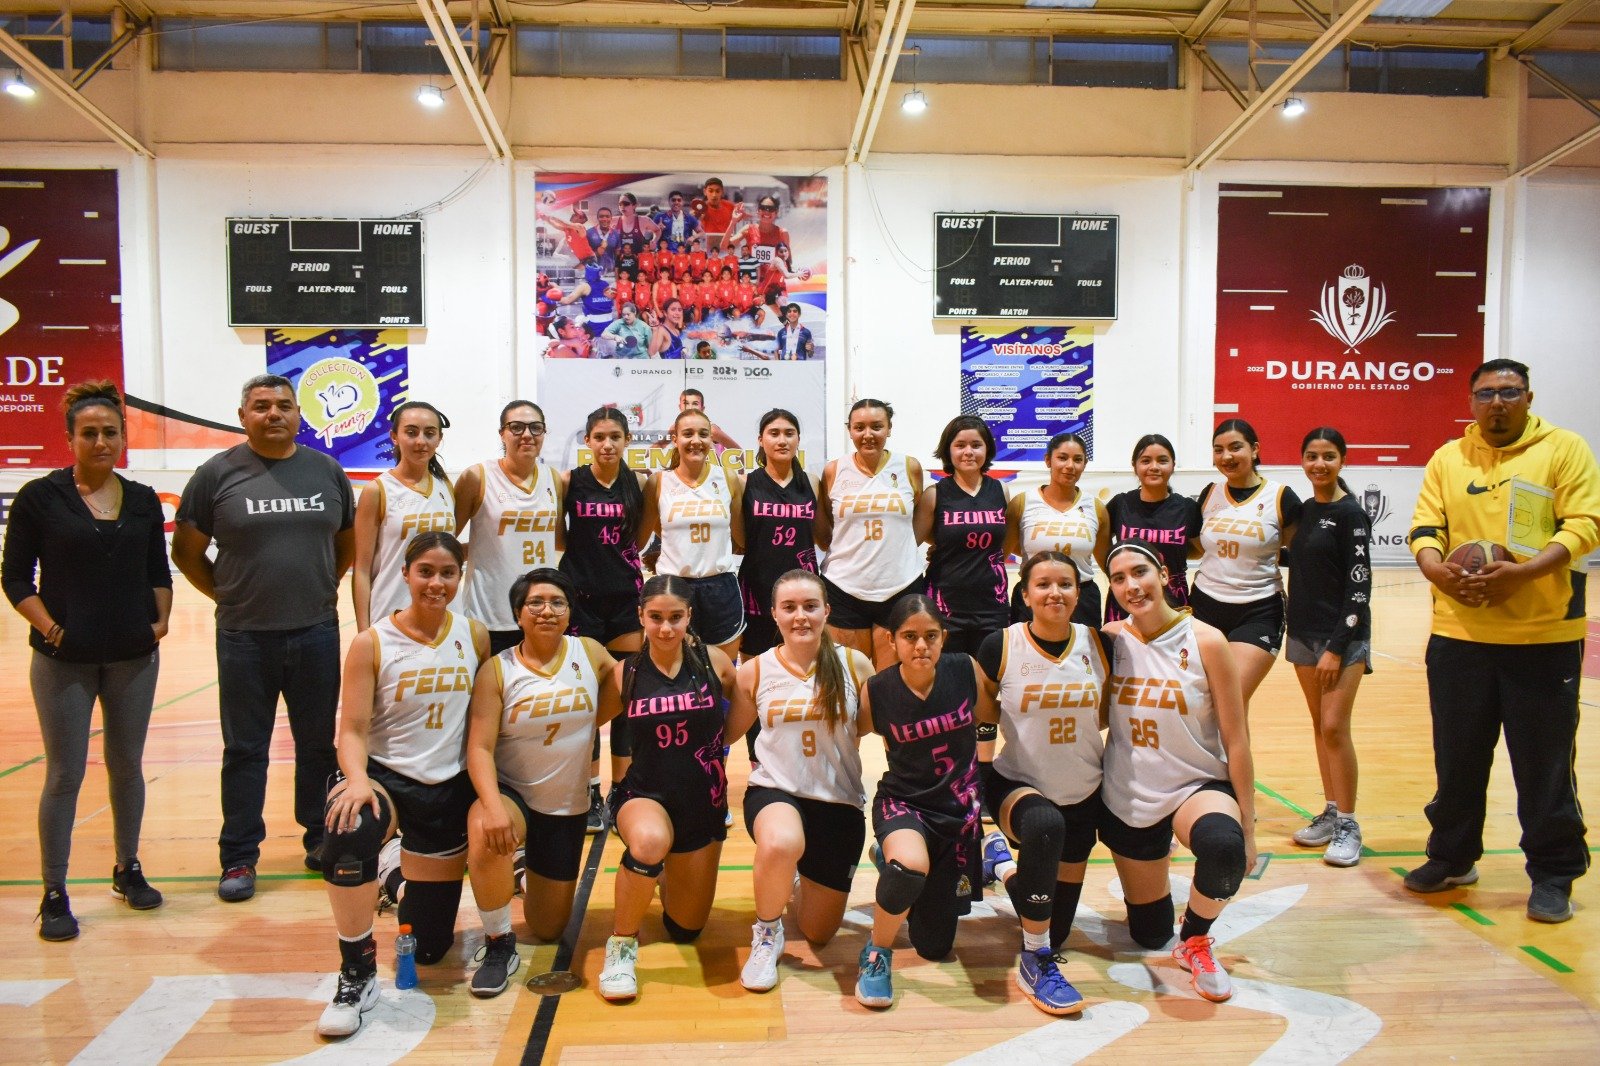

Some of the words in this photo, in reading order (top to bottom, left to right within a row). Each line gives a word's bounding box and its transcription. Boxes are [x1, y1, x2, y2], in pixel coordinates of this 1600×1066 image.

[234, 223, 279, 234] GUEST
[373, 224, 413, 235] HOME
[942, 218, 984, 229] GUEST
[1071, 220, 1109, 231] HOME
[755, 250, 771, 261] 696
[994, 257, 1030, 266] PERIOD
[290, 262, 330, 272] PERIOD
[245, 285, 272, 293] FOULS
[298, 285, 356, 293] PLAYER-FOUL
[999, 278, 1054, 286] PLAYER-FOUL
[379, 316, 410, 324] POINTS
[1000, 308, 1028, 316] MATCH
[305, 363, 366, 386] COLLECTION
[713, 366, 737, 375] 2024
[1266, 360, 1435, 381] DURANGO
[20, 394, 35, 402] DE
[246, 492, 325, 514] LEONES
[667, 499, 728, 522] FECA
[753, 500, 814, 520] LEONES
[839, 493, 907, 518] FECA
[943, 507, 1006, 525] LEONES
[598, 525, 621, 545] 45
[689, 523, 711, 543] 20
[772, 525, 797, 546] 52
[864, 519, 884, 541] 16
[1031, 522, 1092, 542] FECA
[1120, 524, 1186, 545] LEONES
[966, 532, 992, 550] 80
[1216, 539, 1240, 560] 30
[523, 541, 545, 564] 24
[394, 666, 472, 702] FECA
[508, 686, 594, 724] FECA
[627, 682, 715, 718] LEONES
[1020, 682, 1099, 713] FECA
[425, 703, 444, 729] 11
[890, 697, 973, 743] LEONES
[543, 722, 562, 746] 7
[656, 720, 689, 749] 95
[1050, 716, 1076, 745] 22
[1128, 717, 1159, 749] 26
[802, 730, 816, 757] 9
[932, 743, 954, 775] 5
